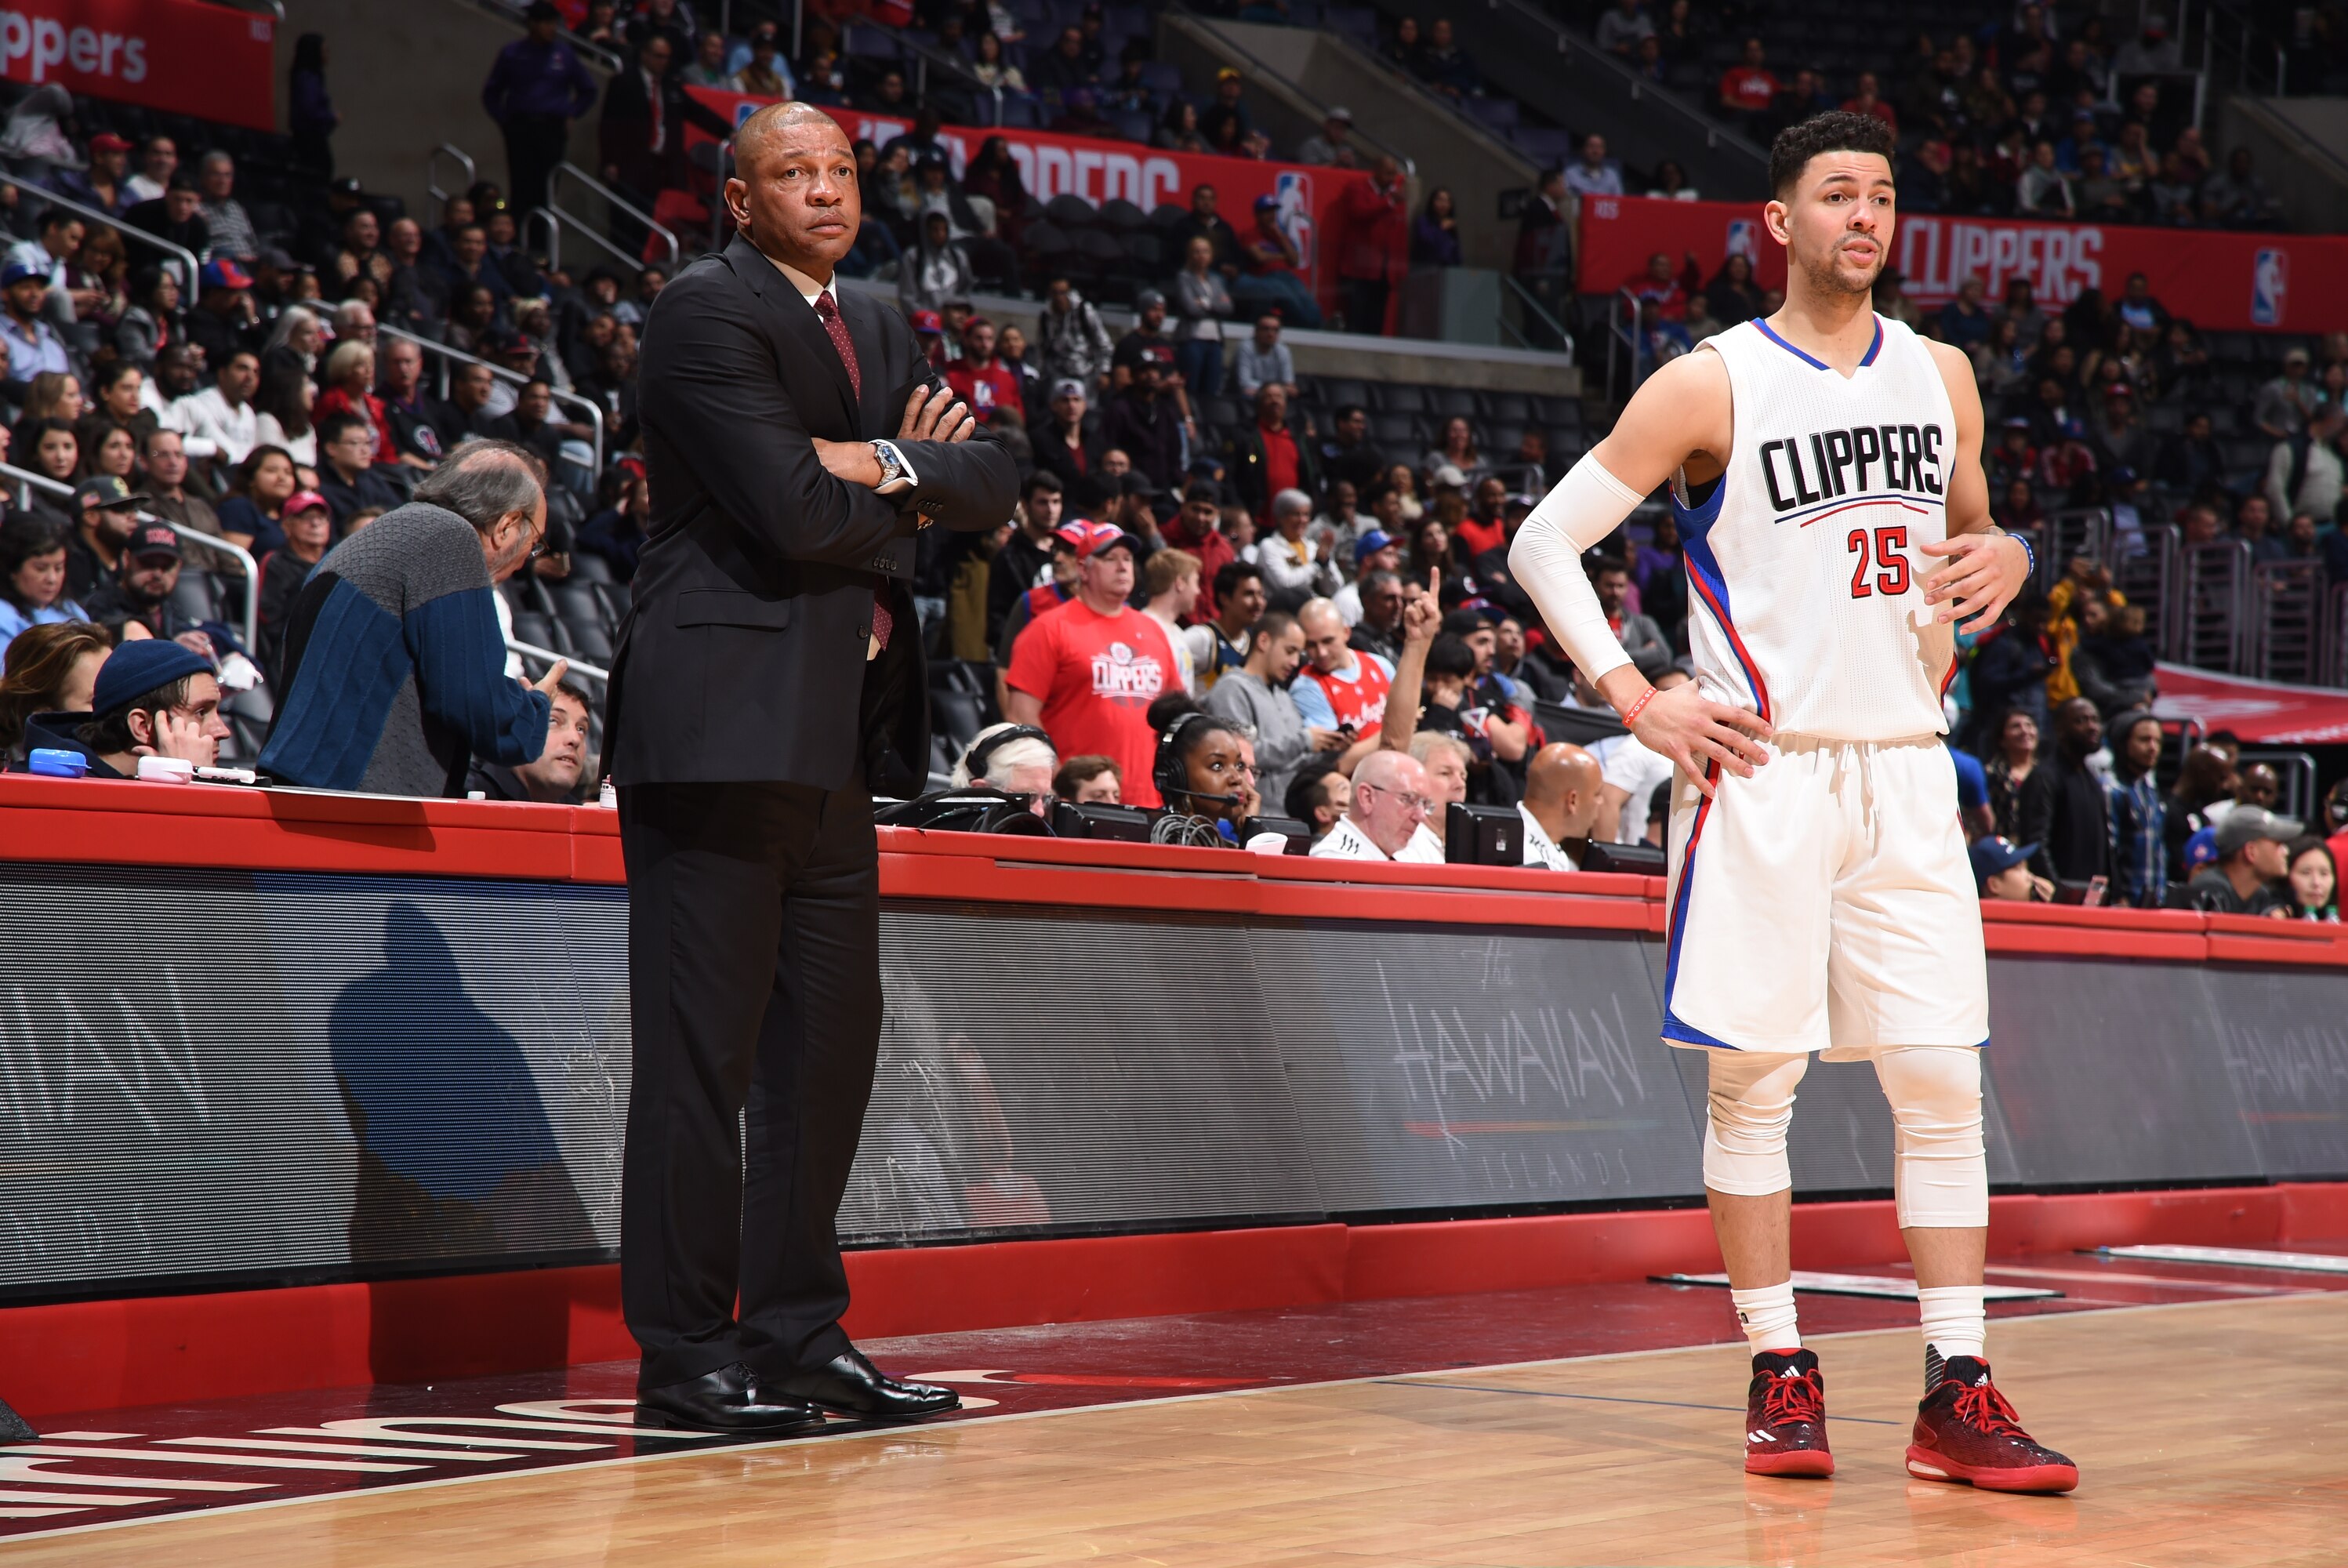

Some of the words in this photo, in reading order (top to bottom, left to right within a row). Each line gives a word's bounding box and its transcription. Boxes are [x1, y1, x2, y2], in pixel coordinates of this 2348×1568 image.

[0, 11, 147, 83] ppers
[1901, 218, 2103, 303] CLIPPERS
[1758, 423, 1943, 512] CLIPPERS
[1847, 525, 1911, 599] 25
[1375, 959, 1645, 1160] HAWAIIAN
[1481, 1148, 1631, 1189] ISLANDS
